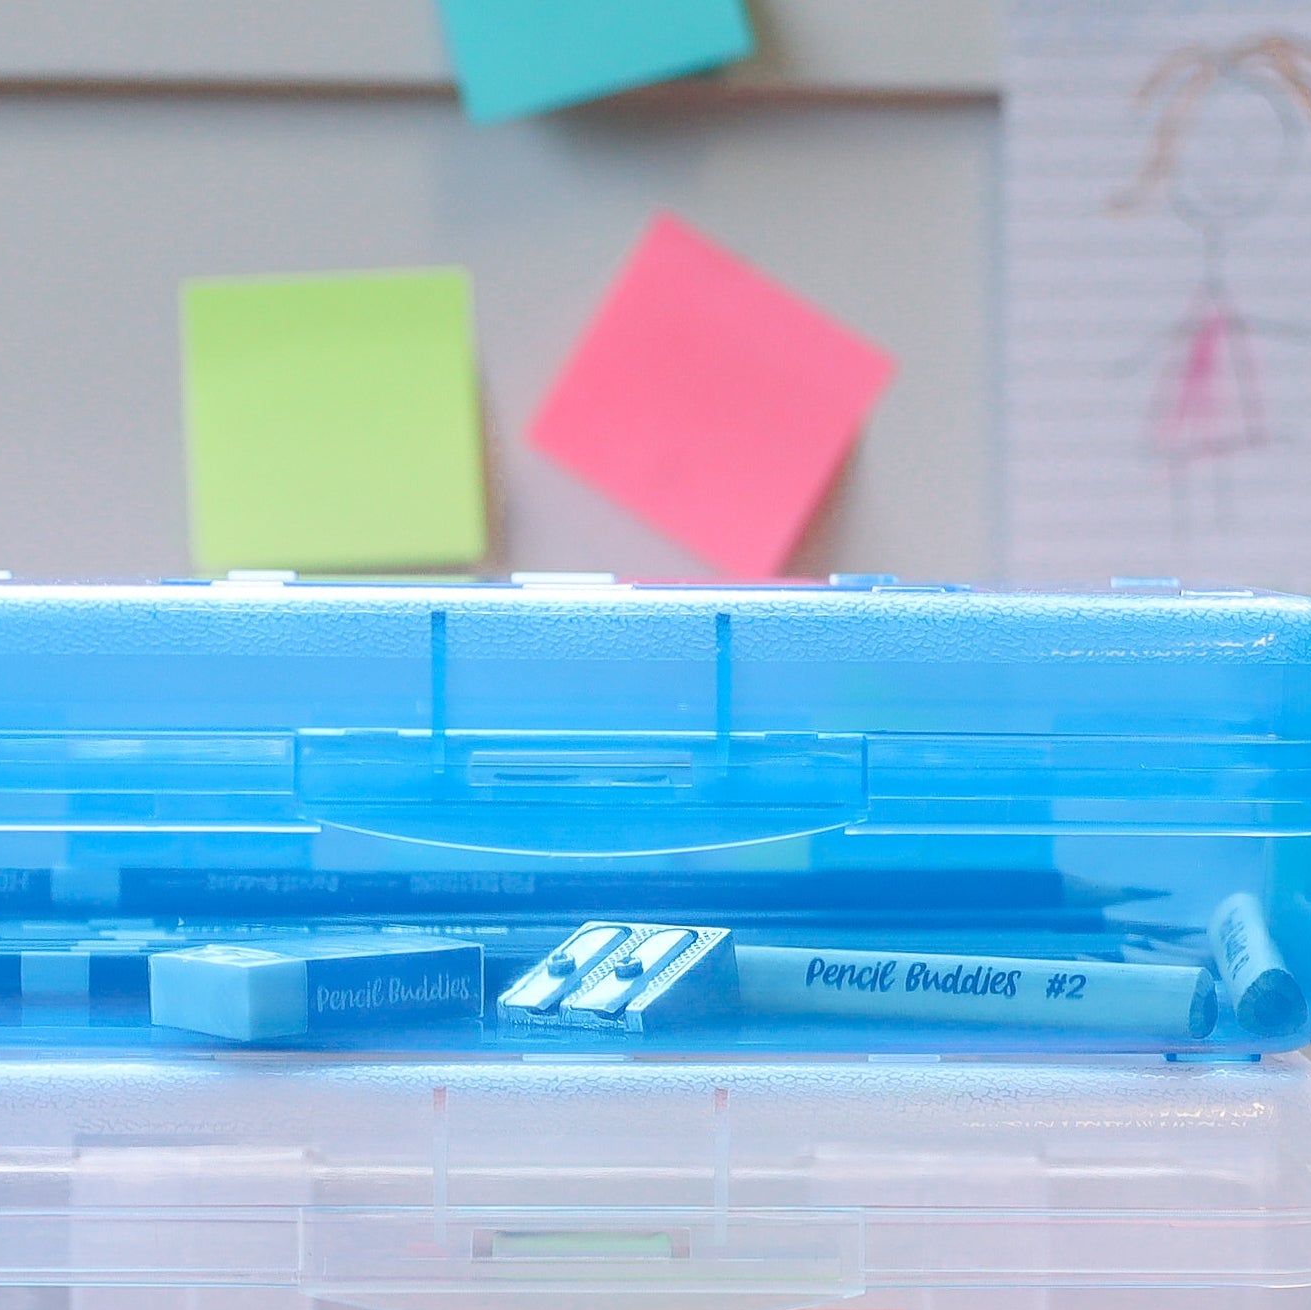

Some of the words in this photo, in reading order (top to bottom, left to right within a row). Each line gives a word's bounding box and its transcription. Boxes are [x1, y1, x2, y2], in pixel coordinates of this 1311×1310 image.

[317, 976, 384, 1013] Pencil
[388, 974, 471, 1004] Buddies
[805, 957, 897, 994] Pencil
[904, 962, 1022, 999] Buddies
[1045, 972, 1088, 1001] #2
